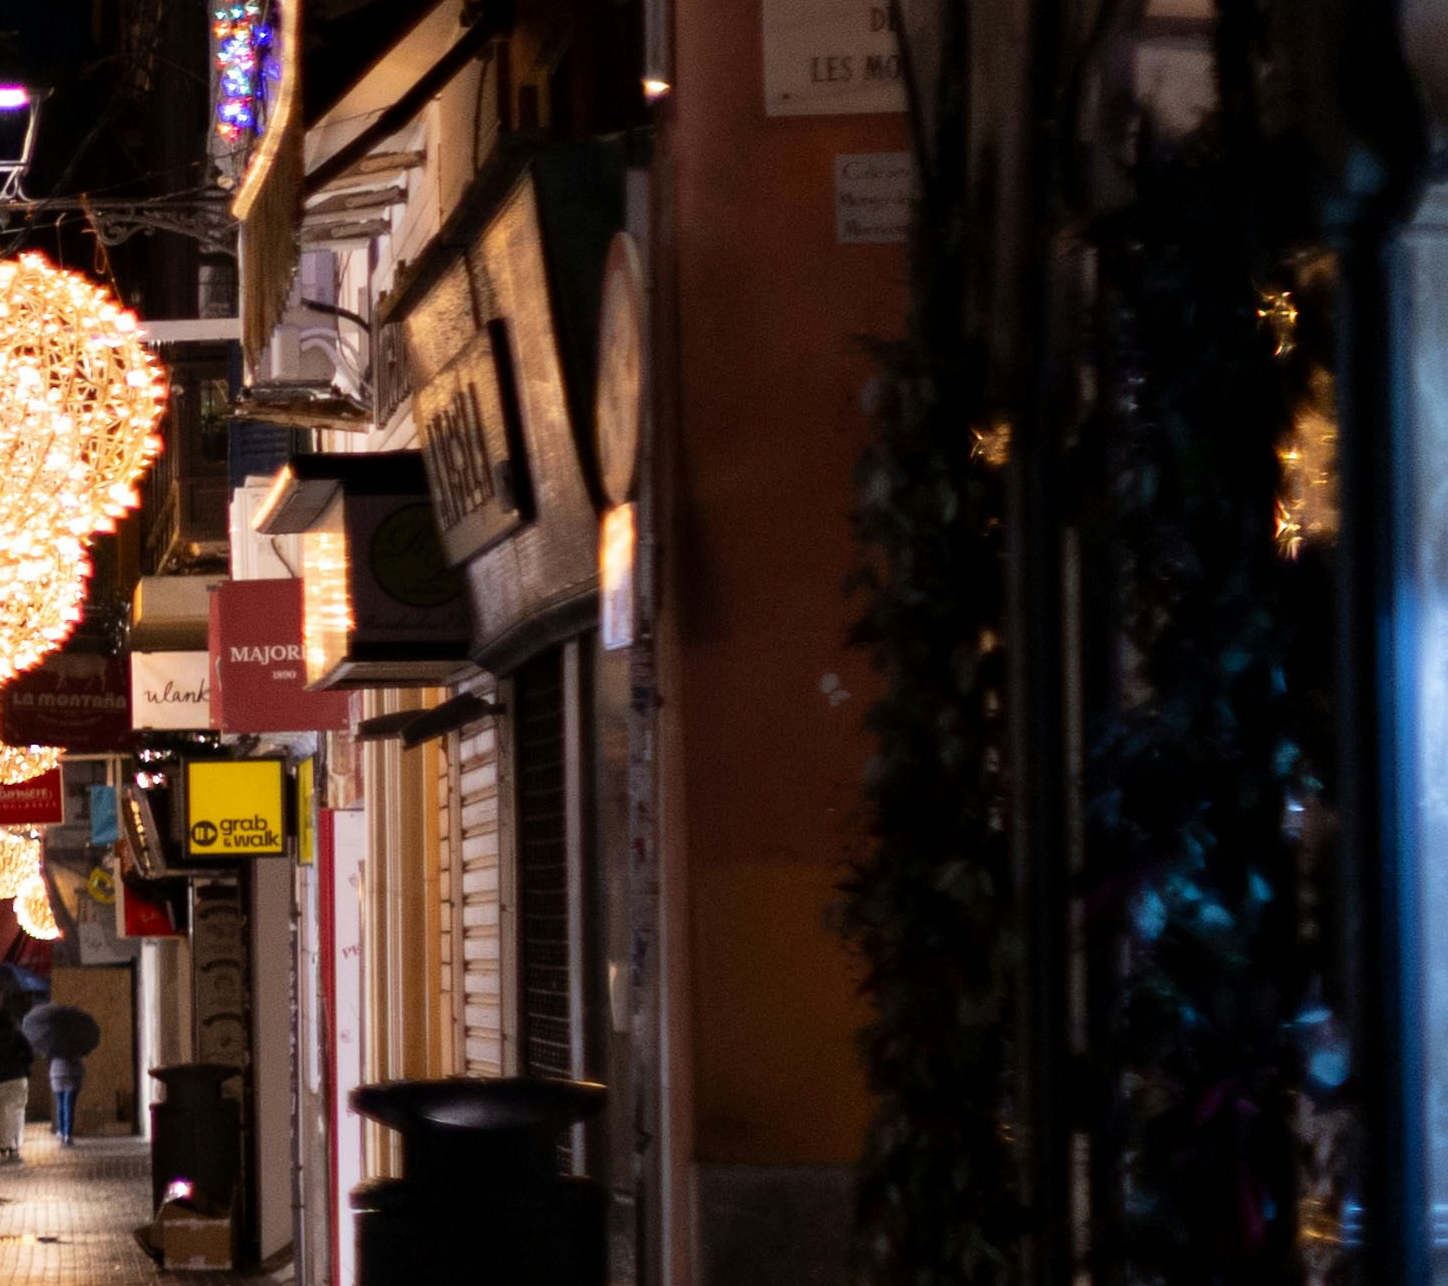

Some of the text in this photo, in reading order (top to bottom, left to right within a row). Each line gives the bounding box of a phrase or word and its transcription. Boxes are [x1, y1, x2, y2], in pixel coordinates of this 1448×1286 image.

[810, 56, 853, 83] LES
[220, 814, 268, 835] grab
[234, 830, 280, 847] walk
